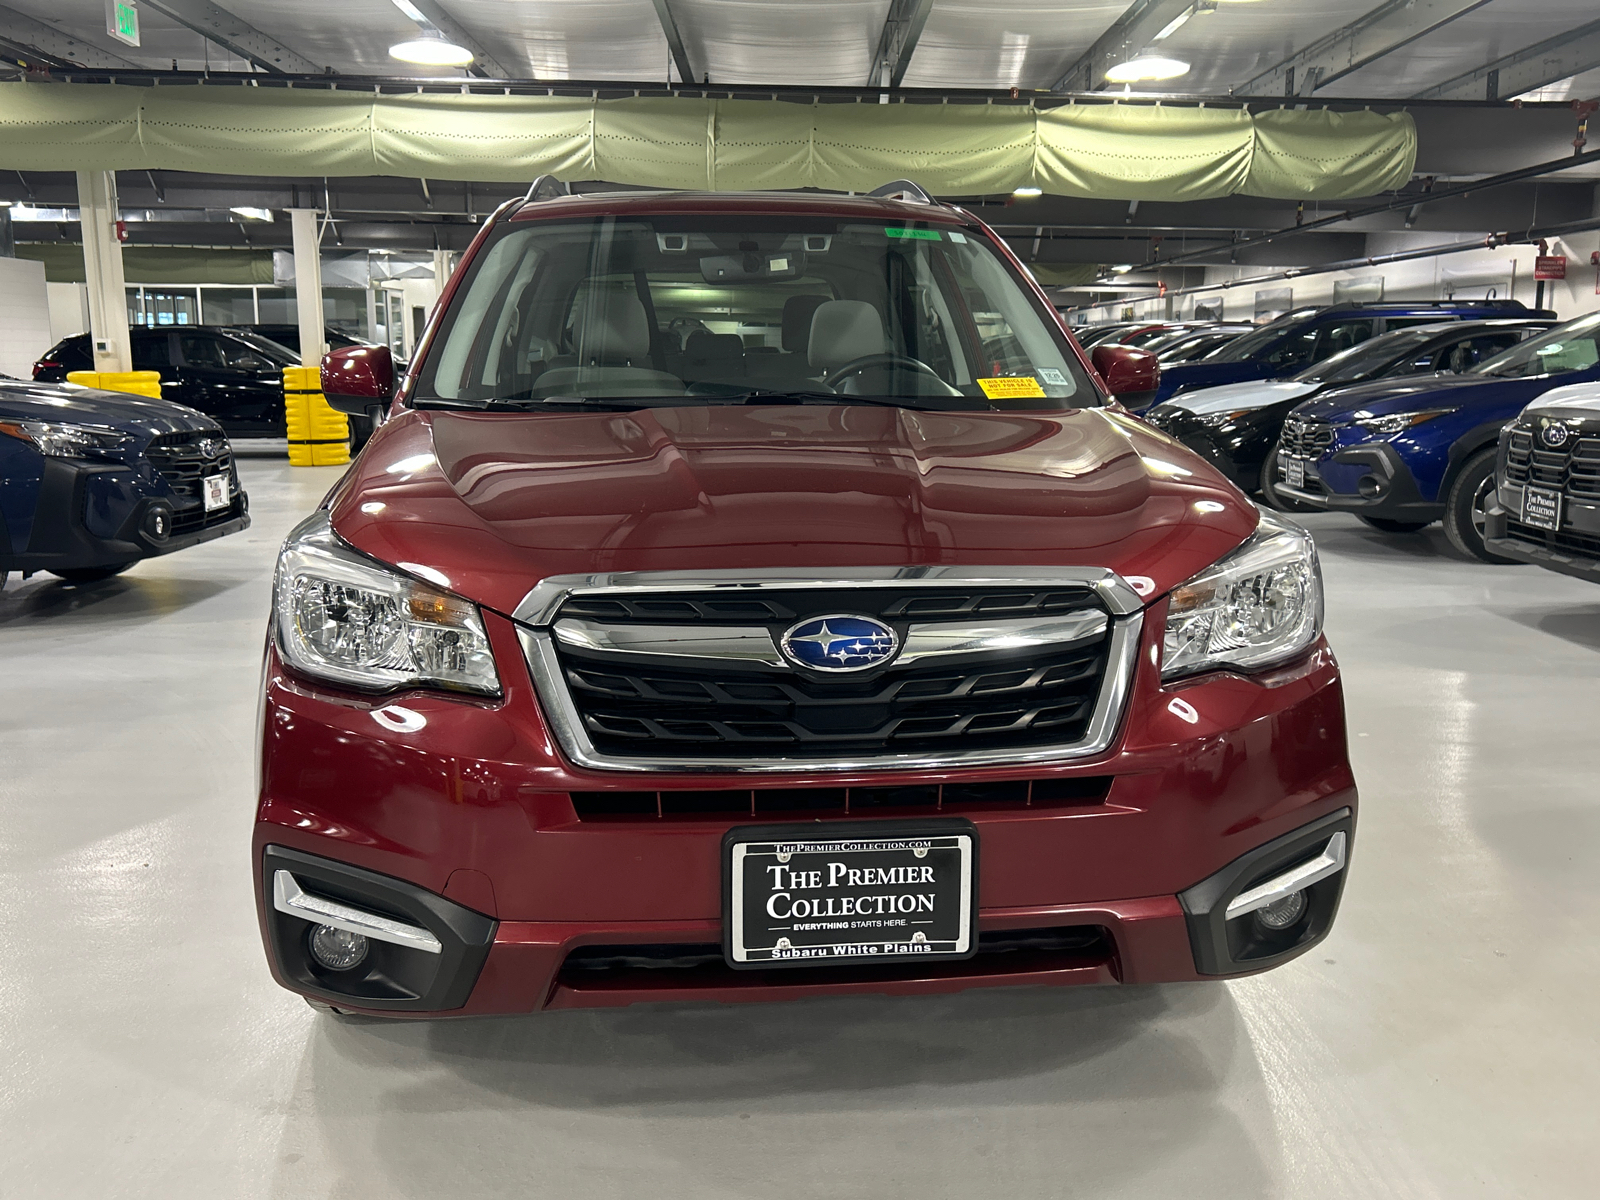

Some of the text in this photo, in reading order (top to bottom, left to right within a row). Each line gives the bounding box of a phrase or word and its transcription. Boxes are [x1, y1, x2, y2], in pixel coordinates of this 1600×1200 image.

[118, 3, 135, 39] EXIT
[767, 862, 936, 890] THE PREMIER
[766, 893, 936, 919] COLLECTION
[794, 919, 907, 931] EVERYTHING STARTS HERE.
[772, 943, 931, 958] Subaru White Plains
